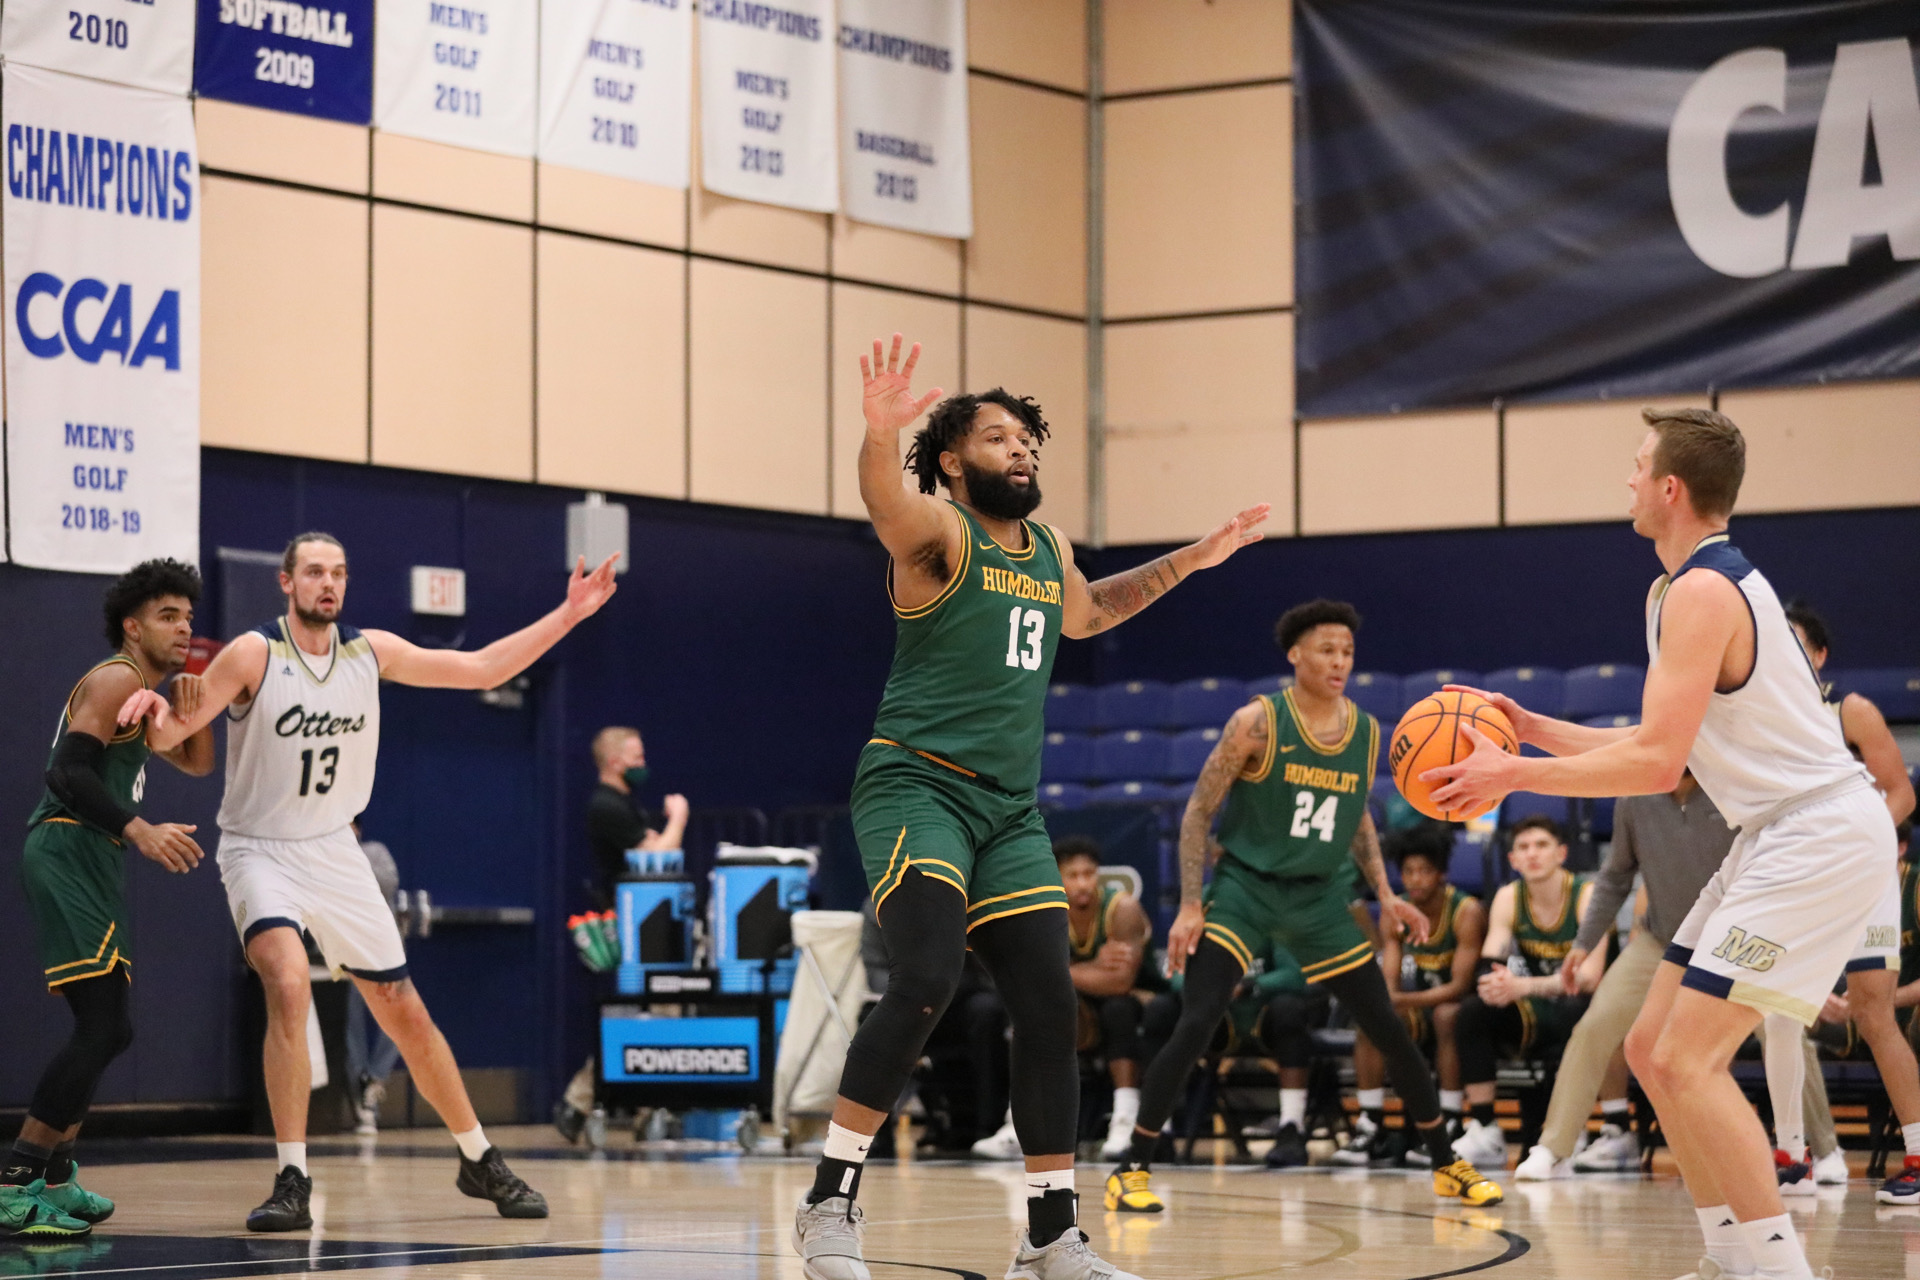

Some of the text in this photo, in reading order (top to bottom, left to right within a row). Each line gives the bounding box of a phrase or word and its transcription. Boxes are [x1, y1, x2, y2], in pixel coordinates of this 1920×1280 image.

[68, 11, 129, 49] 2010
[219, 0, 353, 48] SOFTBALL
[430, 2, 488, 35] MEN'S
[434, 42, 482, 70] GOLF
[588, 38, 644, 69] MEN'S
[839, 24, 952, 74] CHAMPIONS
[255, 47, 314, 89] 2009
[434, 83, 482, 118] 2011
[594, 76, 636, 103] GOLF
[591, 116, 638, 149] 2010
[8, 123, 192, 222] CHAMPIONS
[16, 272, 181, 372] CCAA
[64, 422, 135, 453] MEN'S
[73, 465, 128, 492] GOLF
[62, 504, 141, 535] 2018-19
[982, 566, 1062, 606] HUMBOLDT
[1005, 606, 1046, 671] 13
[275, 704, 367, 738] Otters
[299, 746, 340, 797] 13
[1284, 763, 1359, 794] HUMBOLDT
[1289, 791, 1339, 842] 24
[625, 1049, 749, 1072] POWERADE
